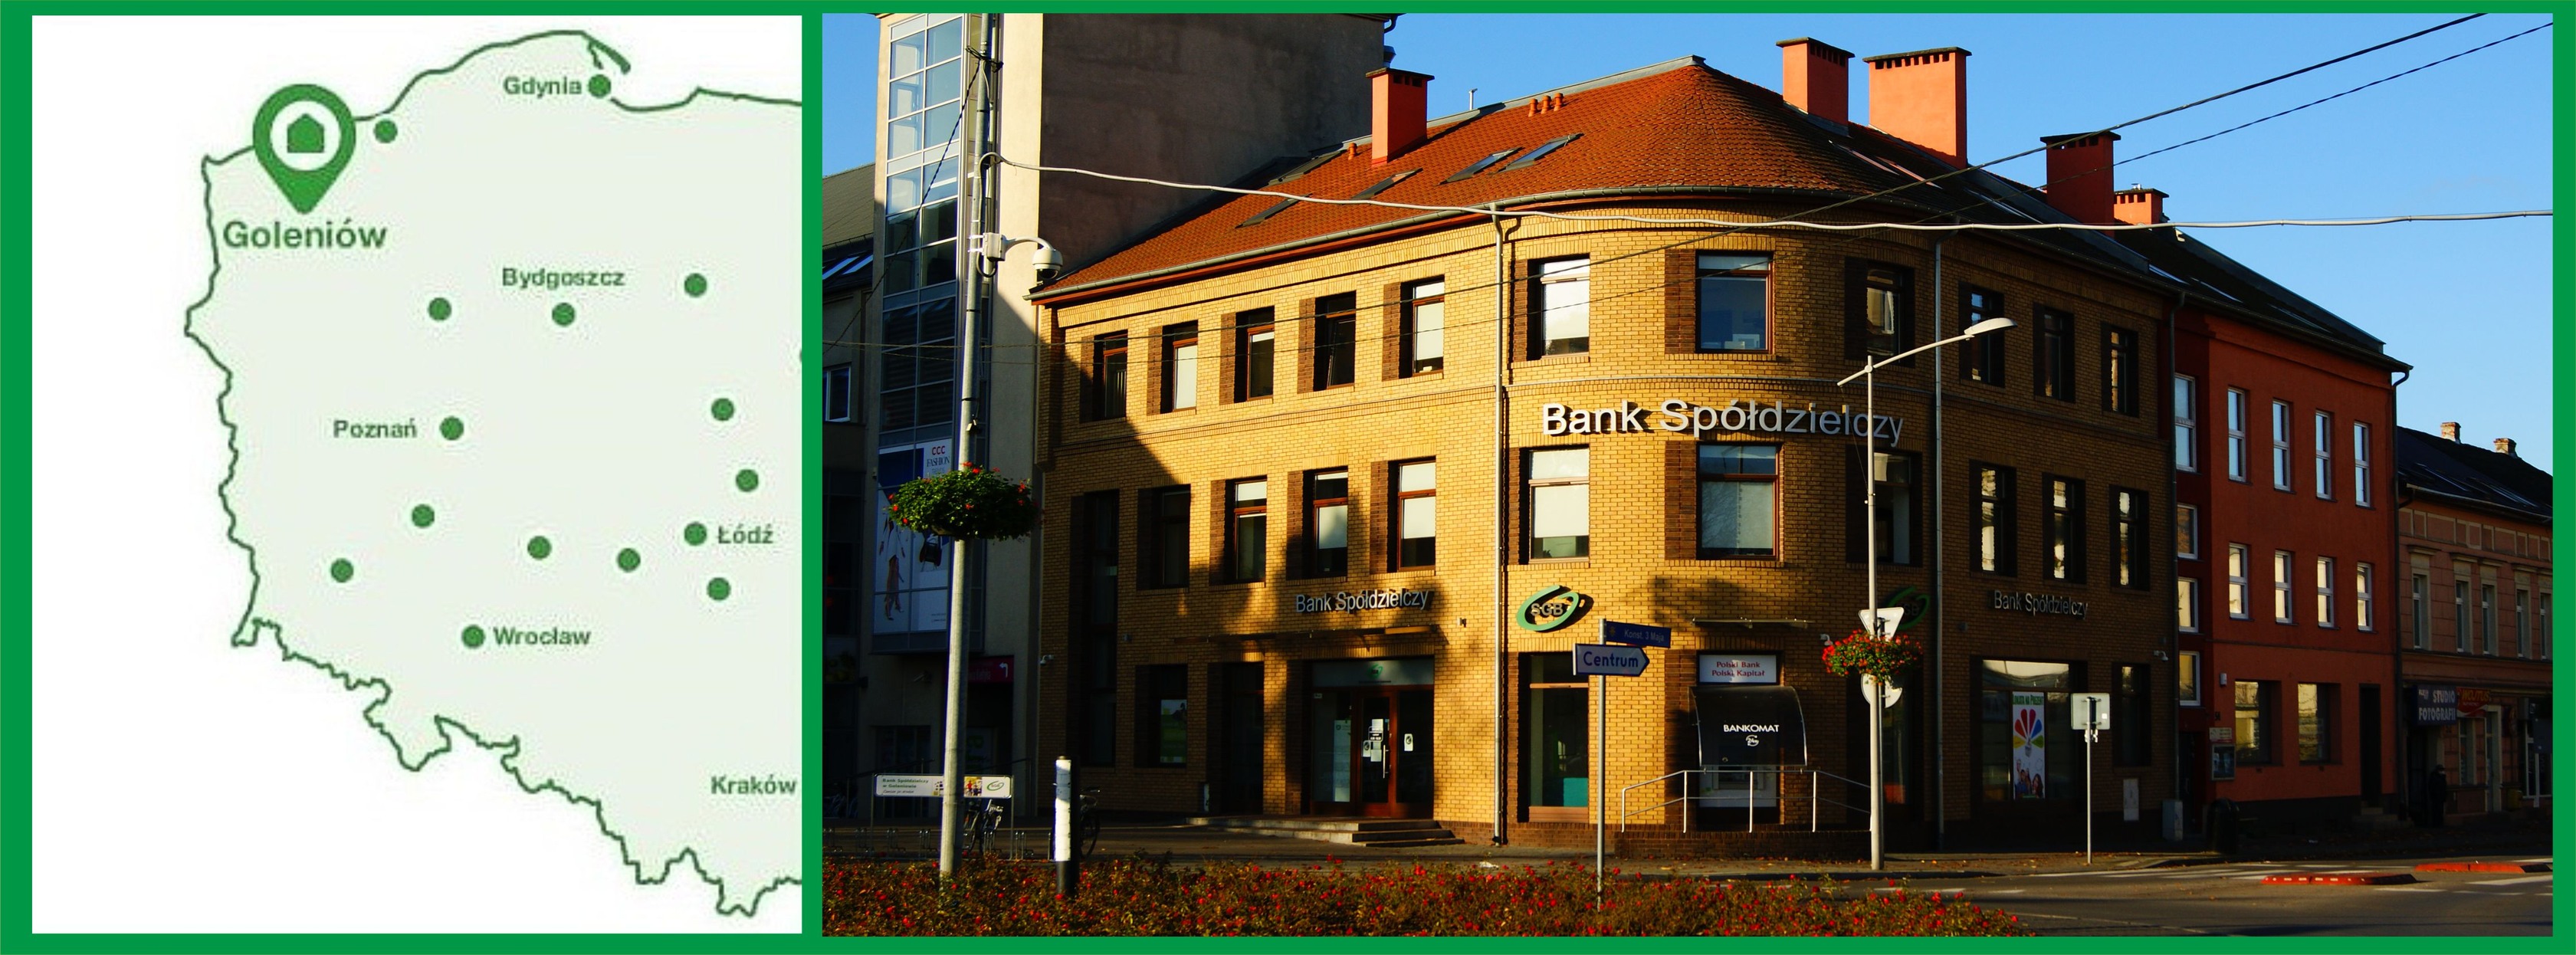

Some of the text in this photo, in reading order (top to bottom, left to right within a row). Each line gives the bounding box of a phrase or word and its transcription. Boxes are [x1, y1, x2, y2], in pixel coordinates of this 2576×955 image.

[1542, 399, 1904, 448] Bank Spółdzielczy
[932, 445, 946, 455] CCC
[1296, 589, 1429, 614] Bank Spółdzielczy
[1994, 589, 2089, 620] Bank Spółdzielczy
[1531, 602, 1564, 616] SGB
[1624, 628, 1665, 643] Konst. 3 Maja
[1583, 651, 1639, 668] Centrum
[2433, 690, 2456, 704] STUDIO
[2418, 707, 2456, 721] FOTOGRAFII
[1723, 724, 1780, 733] BANKOMAT
